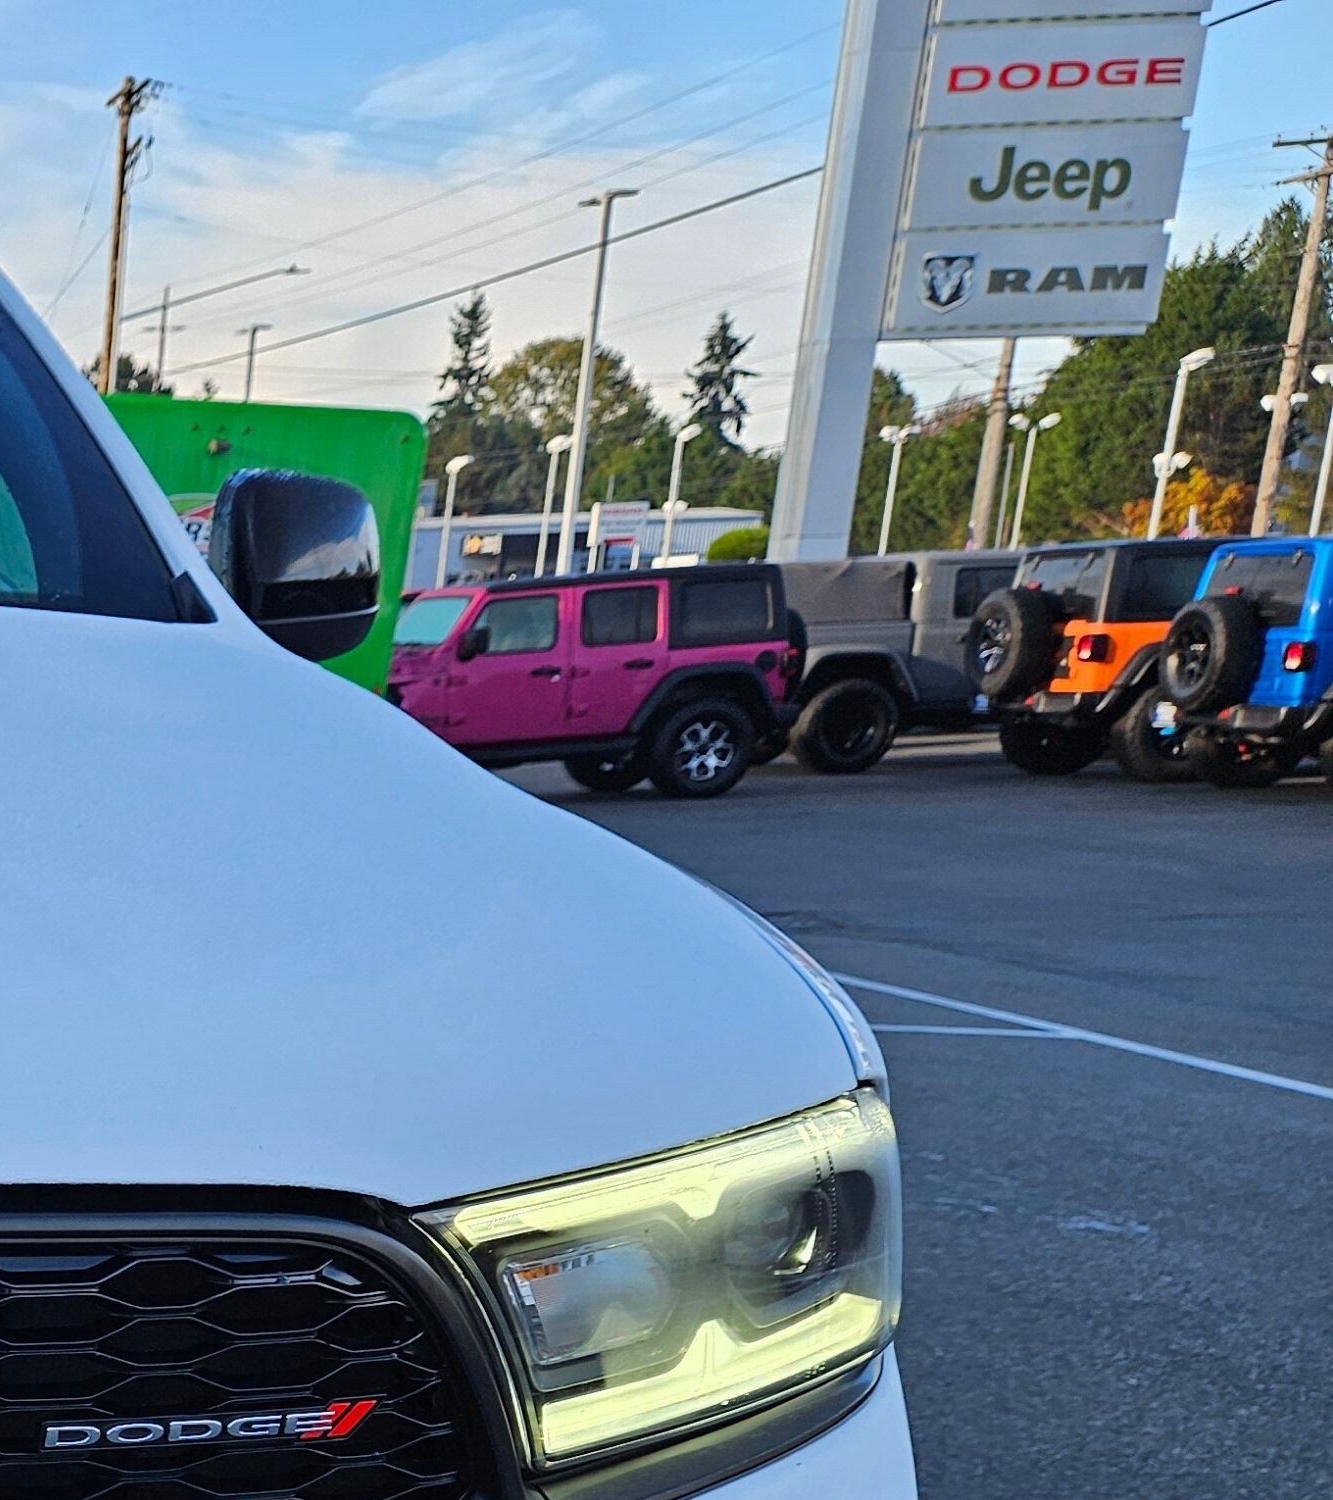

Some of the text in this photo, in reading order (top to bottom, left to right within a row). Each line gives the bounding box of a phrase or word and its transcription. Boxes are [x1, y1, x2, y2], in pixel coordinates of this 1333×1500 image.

[947, 57, 1186, 95] DODGE
[968, 145, 1132, 211] Jeep
[986, 264, 1149, 295] RAM
[44, 1410, 335, 1448] DODGE
